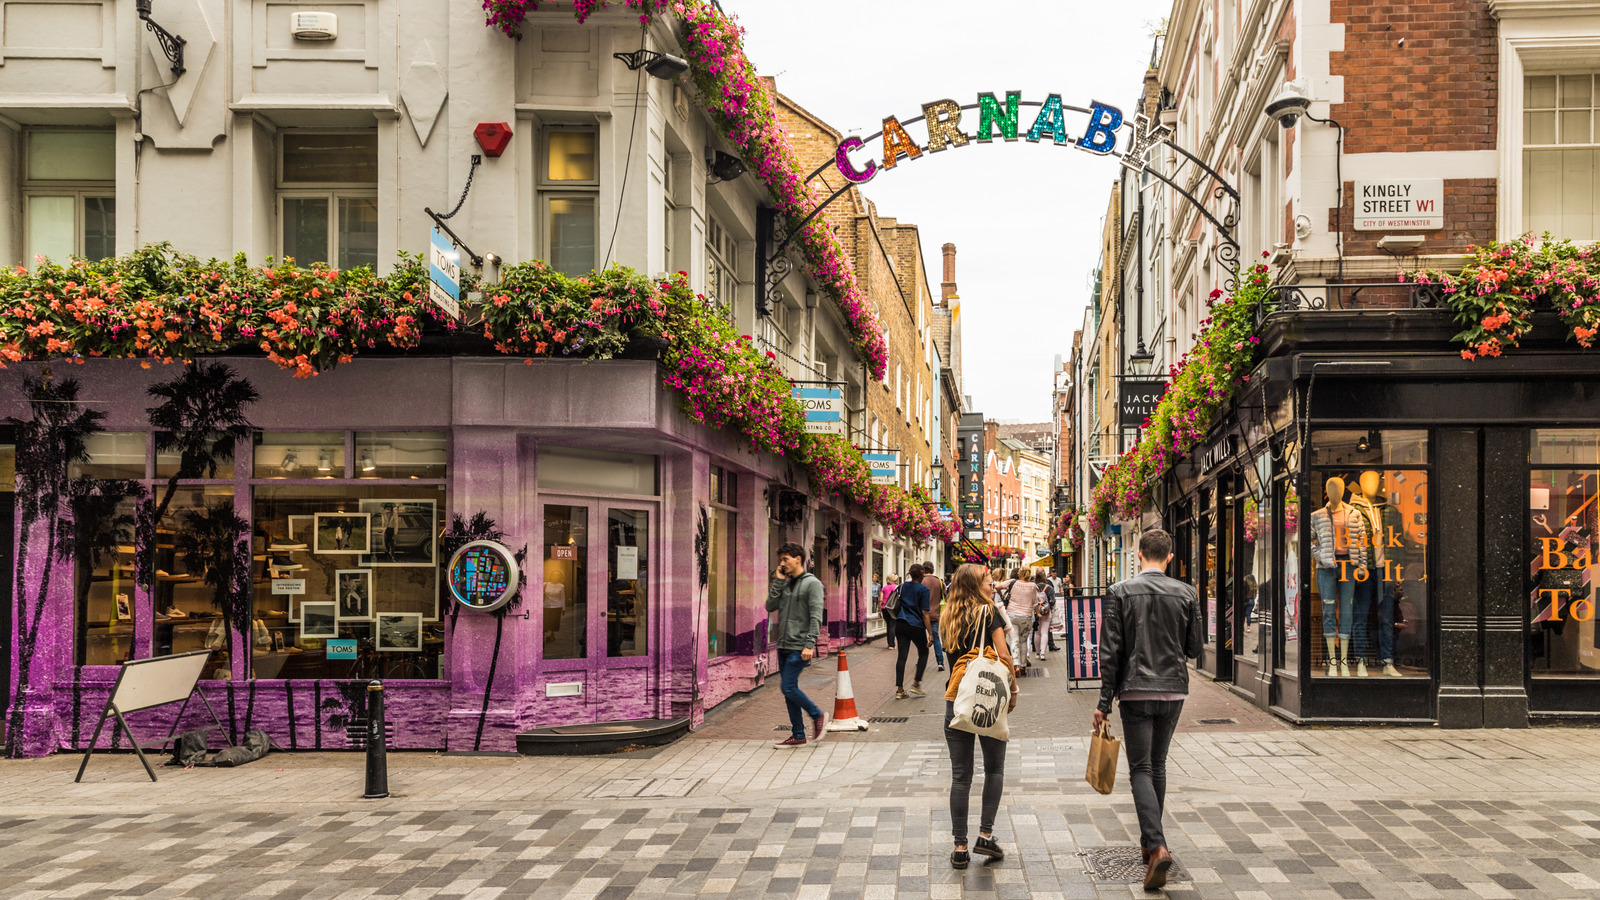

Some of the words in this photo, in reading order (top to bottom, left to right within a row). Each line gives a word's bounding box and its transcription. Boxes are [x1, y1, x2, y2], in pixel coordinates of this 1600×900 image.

[835, 90, 1173, 183] CARNABY
[1363, 184, 1411, 198] KINGLY
[1363, 200, 1411, 213] STREET
[1416, 199, 1434, 212] W1
[1387, 219, 1431, 227] WESTMINSTER
[436, 249, 455, 279] TOMS
[799, 399, 832, 410] TOMS
[1126, 394, 1159, 404] JACK
[1123, 406, 1156, 415] WILL
[1333, 525, 1405, 548] Back
[556, 549, 572, 557] OPEN
[1538, 537, 1600, 570] Ba
[1333, 559, 1370, 582] To
[1382, 559, 1405, 582] It
[1538, 588, 1595, 622] To
[976, 684, 997, 697] BERLIN
